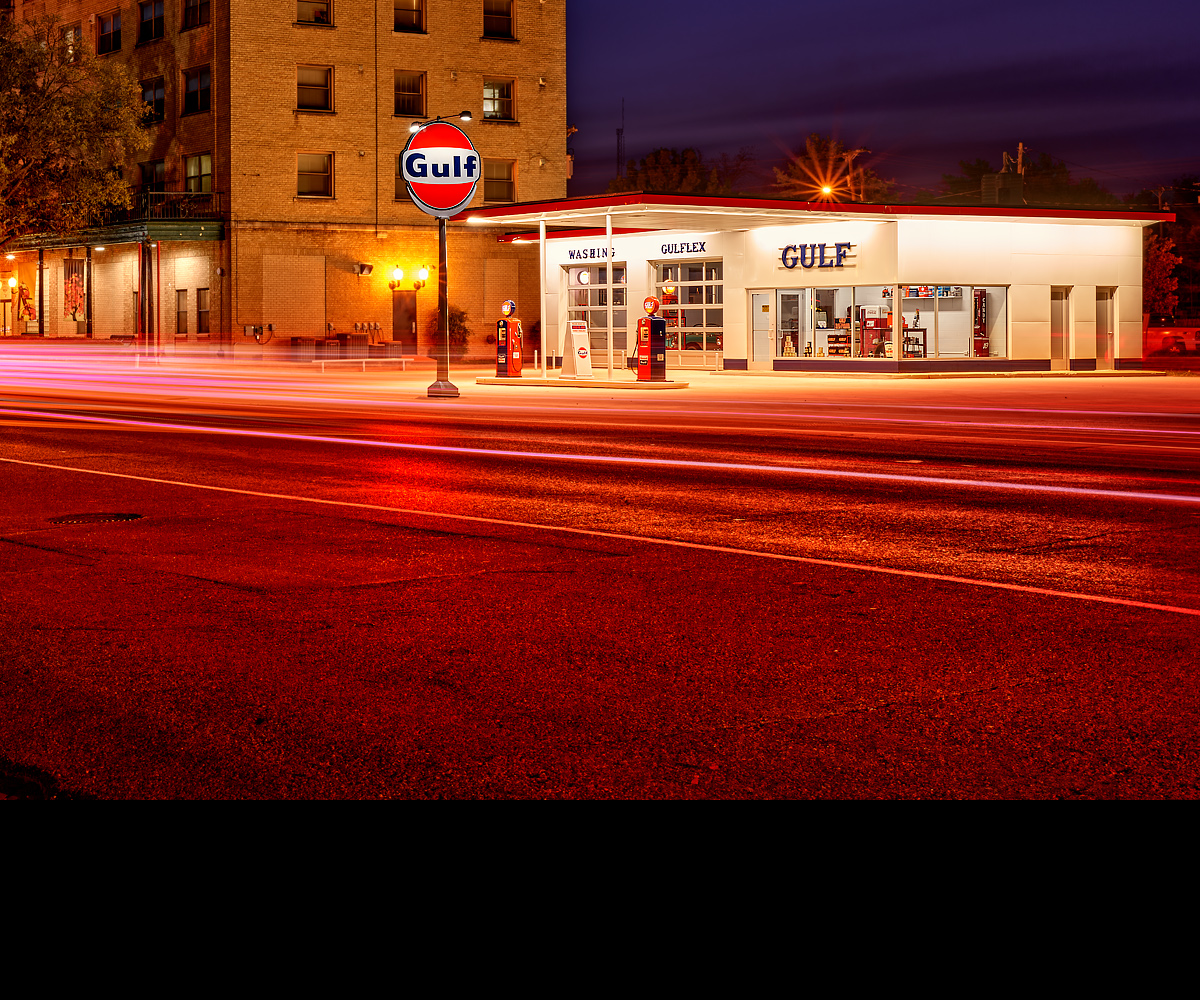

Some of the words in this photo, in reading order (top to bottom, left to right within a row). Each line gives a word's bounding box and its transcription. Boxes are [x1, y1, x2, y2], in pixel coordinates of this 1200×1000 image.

[405, 153, 477, 178] Gulf
[568, 247, 616, 260] WASHING
[660, 241, 707, 255] GULFLEX
[781, 241, 851, 269] GULF
